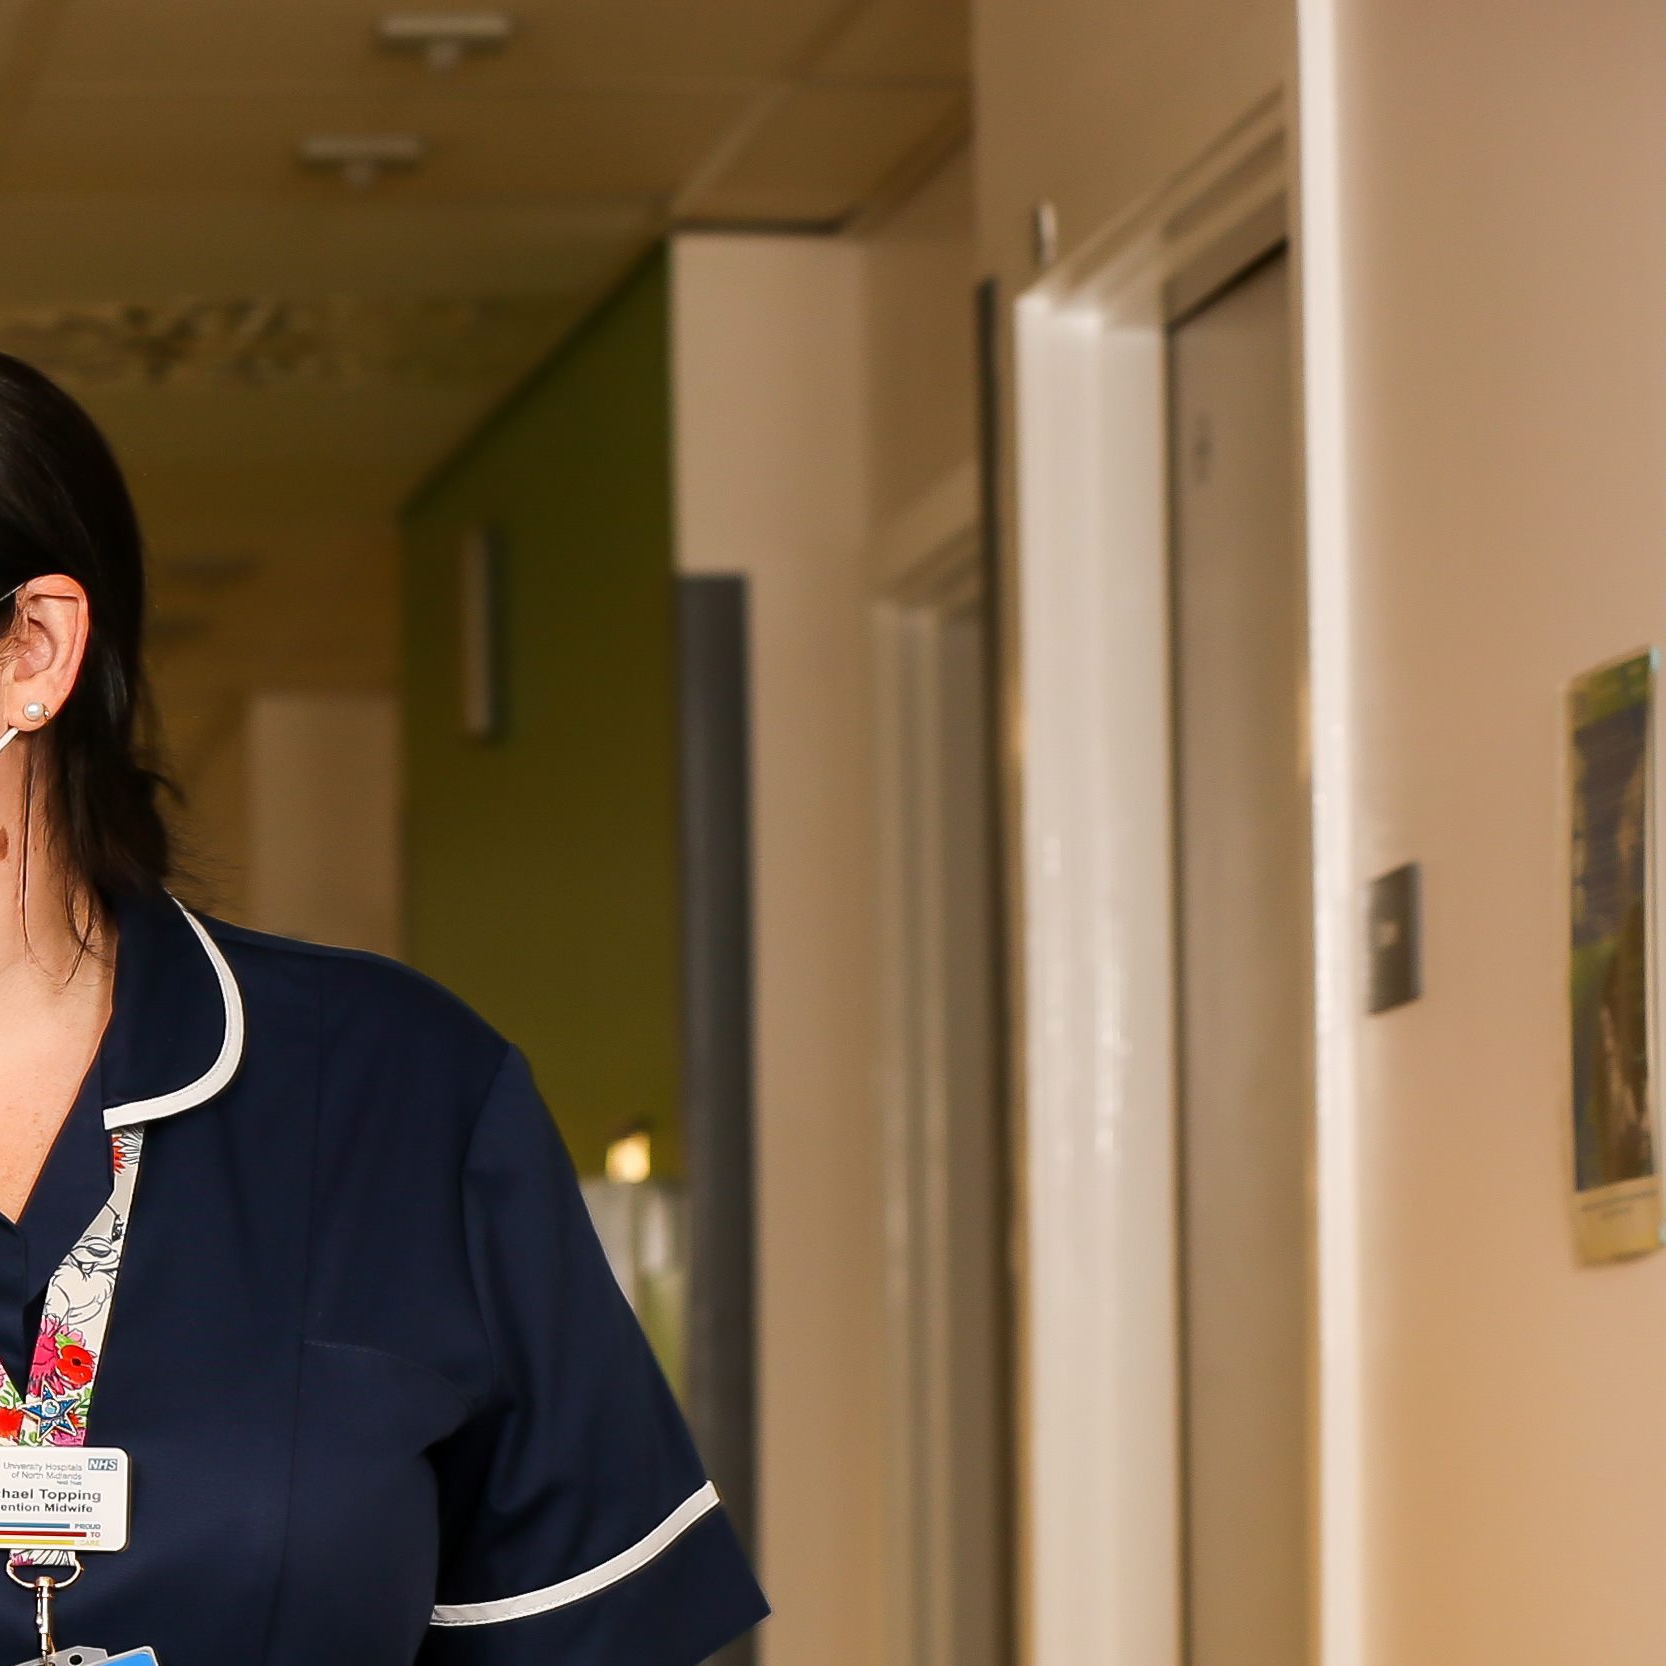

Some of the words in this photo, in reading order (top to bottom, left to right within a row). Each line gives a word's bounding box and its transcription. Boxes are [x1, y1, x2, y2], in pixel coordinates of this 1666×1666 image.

[3, 1461, 43, 1472] University
[45, 1463, 83, 1474] Hospitals
[89, 1459, 118, 1471] NHS
[39, 1488, 102, 1503] Topping
[44, 1503, 94, 1514] Midwife
[74, 1523, 102, 1531] PROUD
